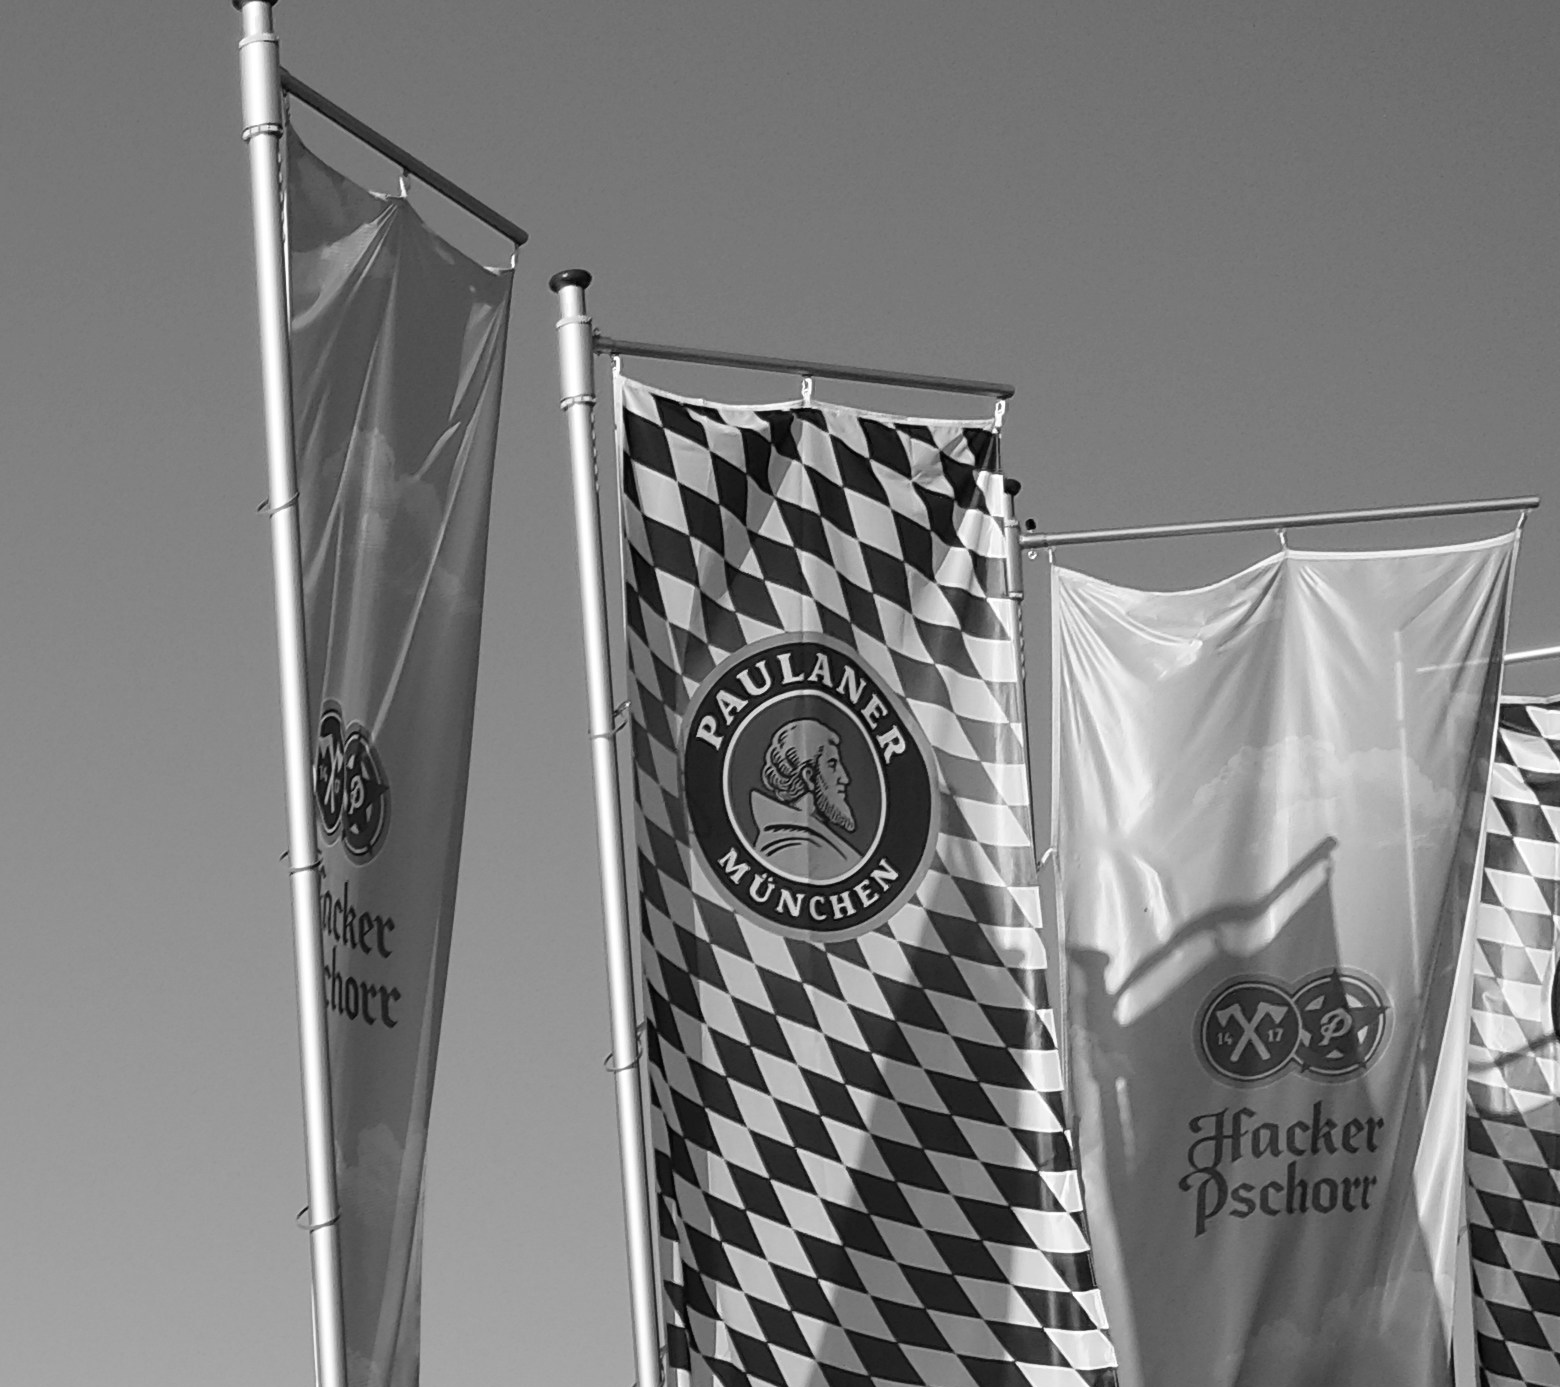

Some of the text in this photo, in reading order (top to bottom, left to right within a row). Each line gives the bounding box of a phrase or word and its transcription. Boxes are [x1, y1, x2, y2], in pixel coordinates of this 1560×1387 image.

[696, 652, 907, 764] PAULANER
[717, 846, 900, 921] MÜNCHEN
[1217, 1028, 1284, 1046] 14 17
[1187, 1101, 1385, 1173] Hacker
[1178, 1161, 1378, 1239] Pschorr
